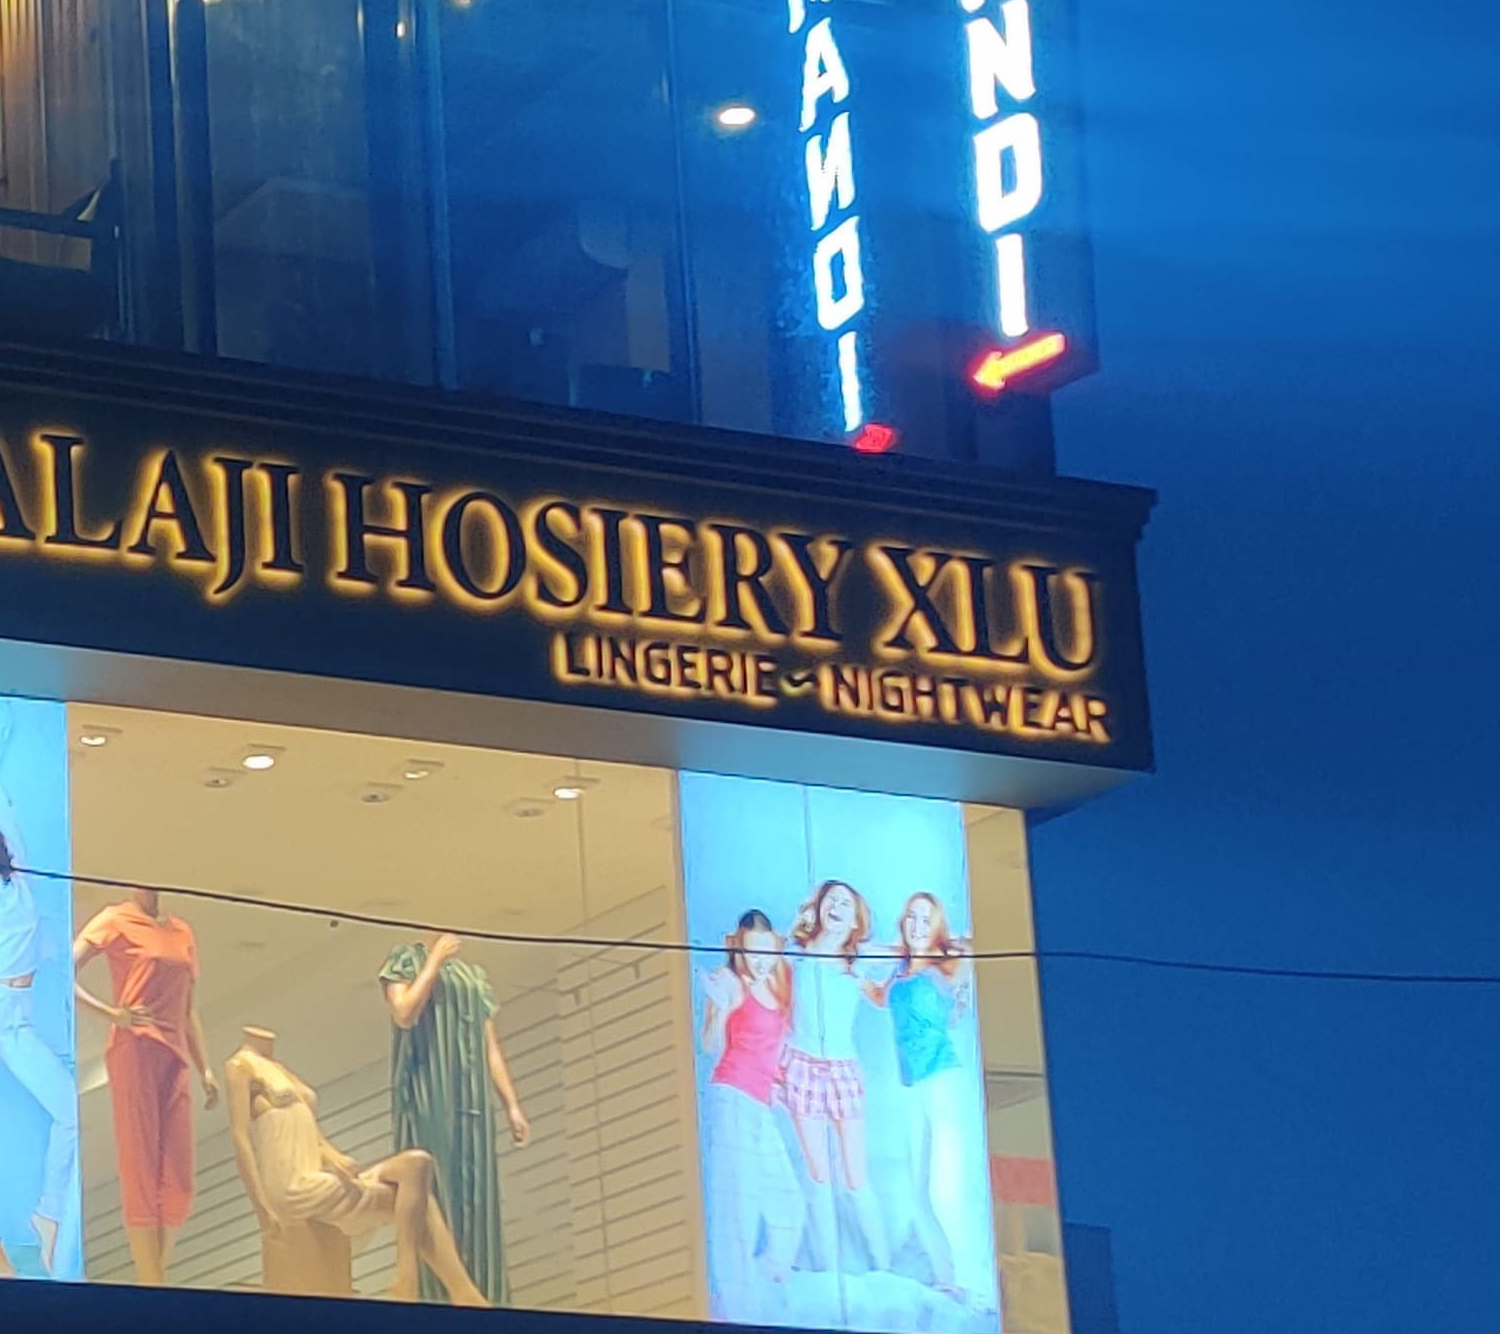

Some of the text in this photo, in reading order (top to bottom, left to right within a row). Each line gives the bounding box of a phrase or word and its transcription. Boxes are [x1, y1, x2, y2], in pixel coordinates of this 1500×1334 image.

[332, 471, 852, 642] HOSIERY
[868, 543, 1100, 673] XLU
[556, 631, 1111, 743] LINGERIE NIGHTWEAR
